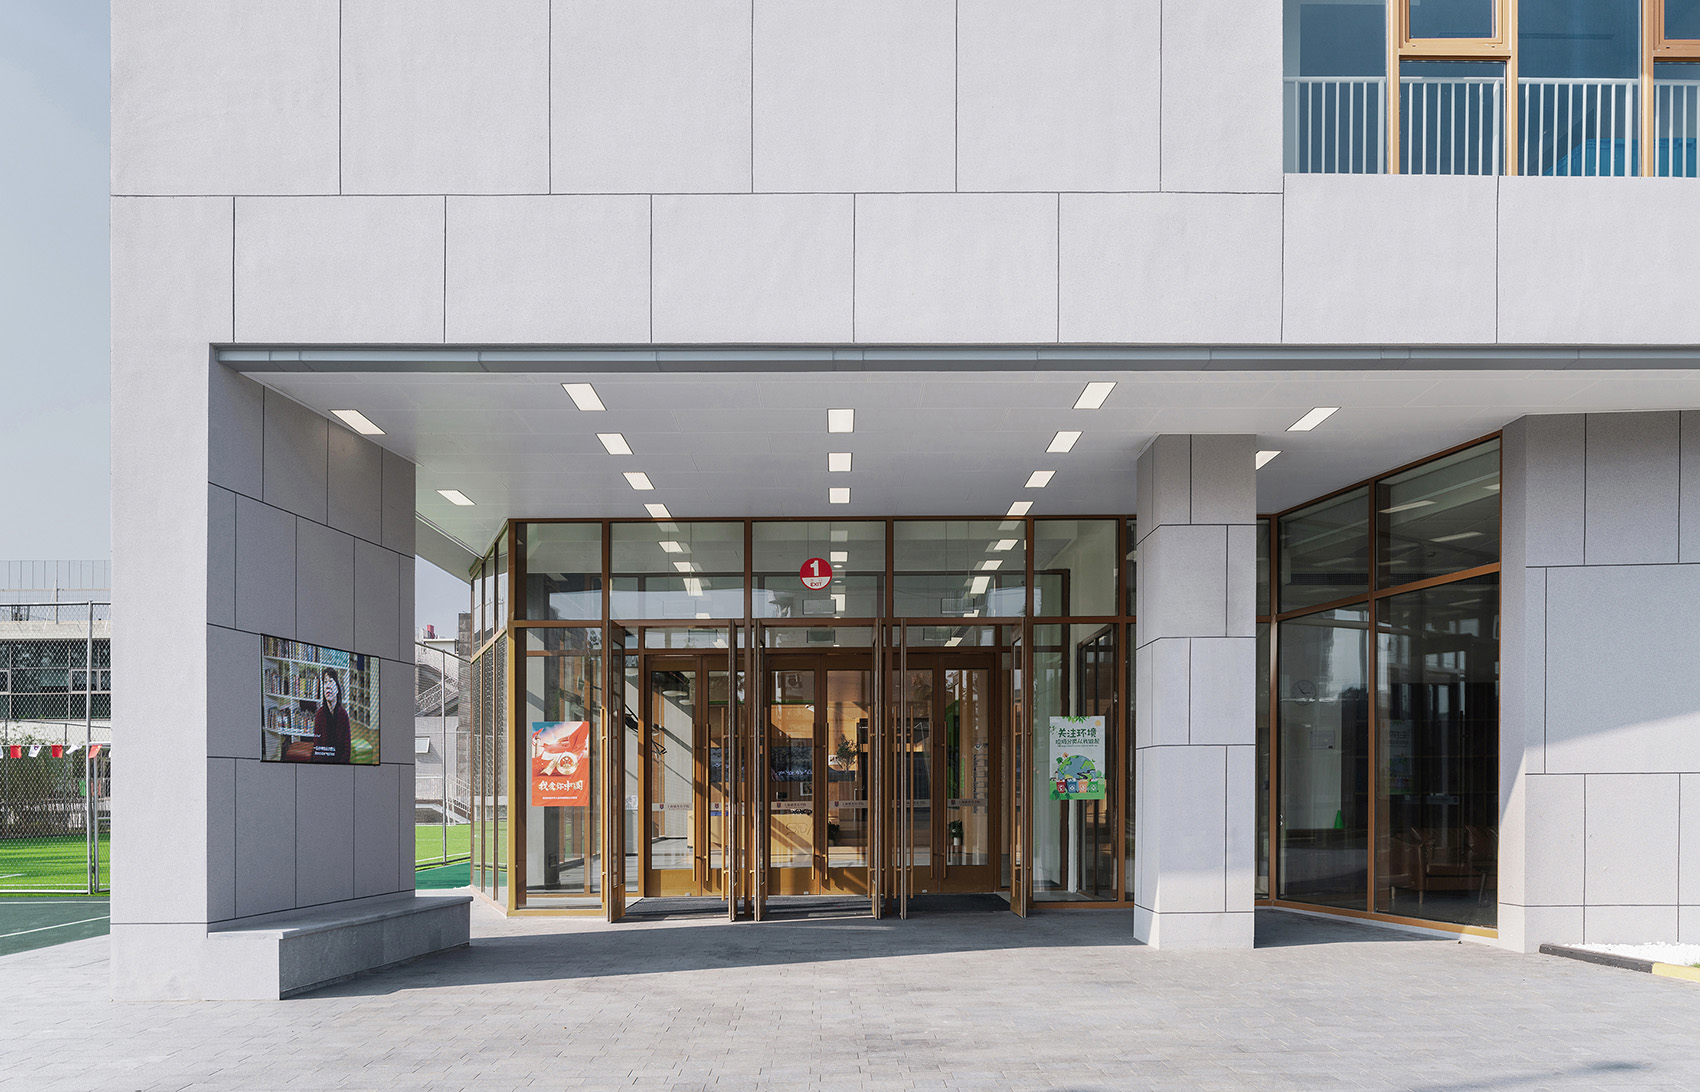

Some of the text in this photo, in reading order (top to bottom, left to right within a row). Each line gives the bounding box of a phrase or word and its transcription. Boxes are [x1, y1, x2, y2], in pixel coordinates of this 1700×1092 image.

[810, 560, 819, 576] 1
[1058, 727, 1097, 738] 关注环境
